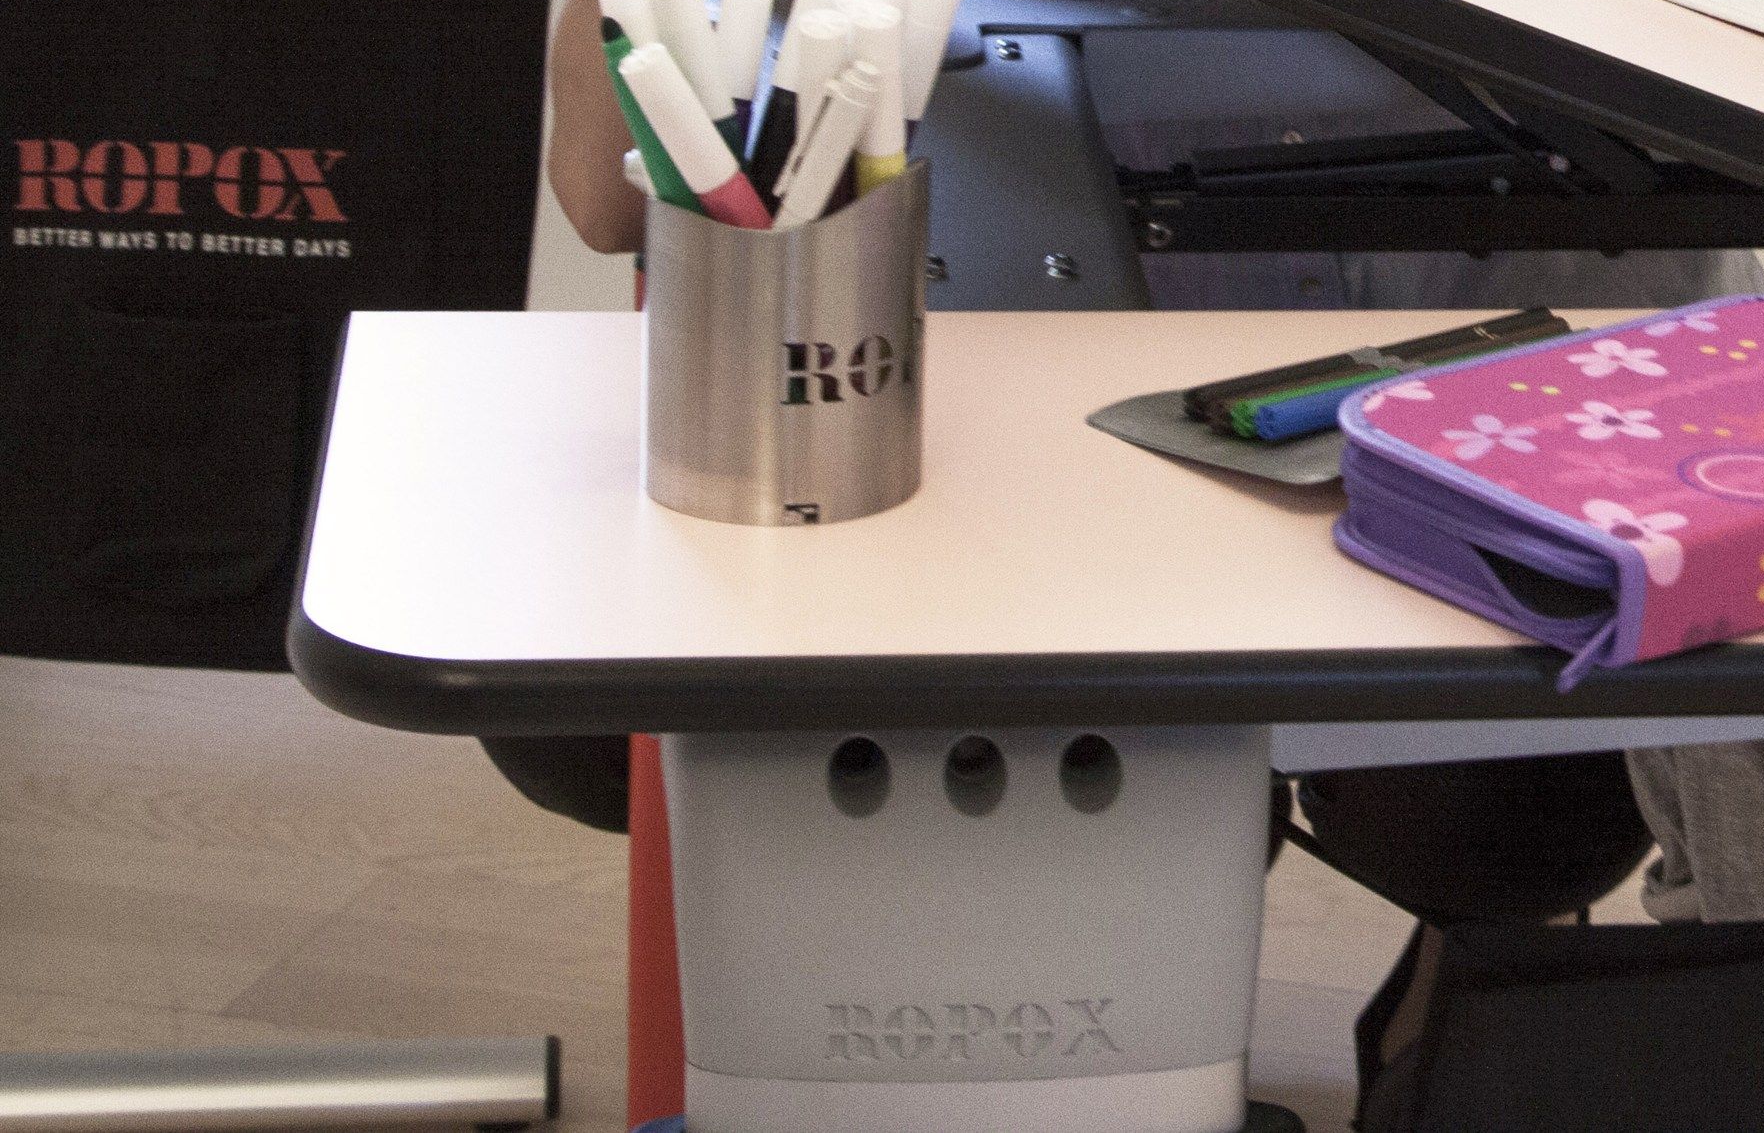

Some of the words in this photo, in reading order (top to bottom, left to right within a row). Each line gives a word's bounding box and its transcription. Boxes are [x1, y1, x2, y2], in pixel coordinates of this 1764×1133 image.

[14, 140, 350, 222] ROPOX
[13, 227, 93, 249] BETTER
[99, 231, 157, 252] WAYS
[165, 232, 194, 253] TO
[201, 235, 285, 257] BETTER
[294, 239, 352, 259] DAYS
[825, 998, 1124, 1061] ROPOX
